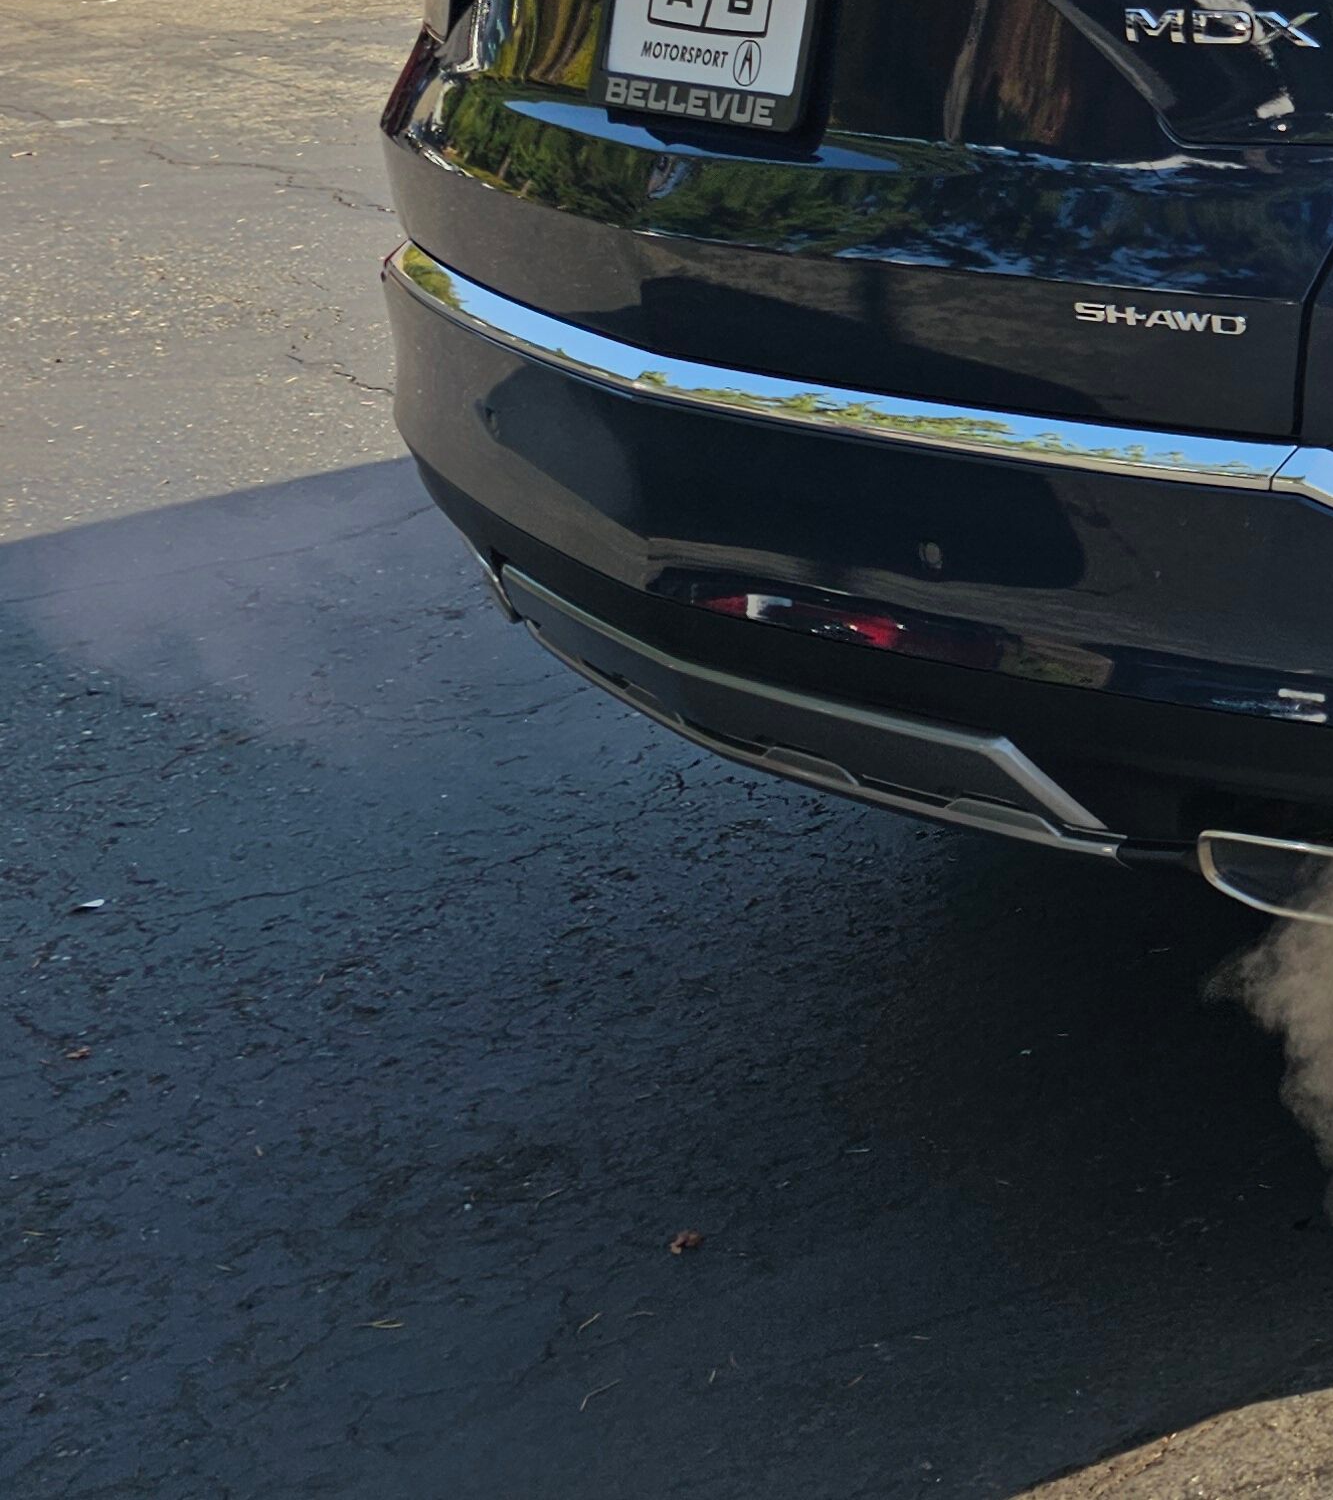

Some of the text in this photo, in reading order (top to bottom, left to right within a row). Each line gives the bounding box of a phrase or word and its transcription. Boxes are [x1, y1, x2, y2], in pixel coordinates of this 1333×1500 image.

[1124, 7, 1321, 48] MDX
[640, 41, 729, 69] MOTORSPORT
[605, 76, 776, 127] BELLEVUE
[1074, 301, 1247, 335] SH-AWD
